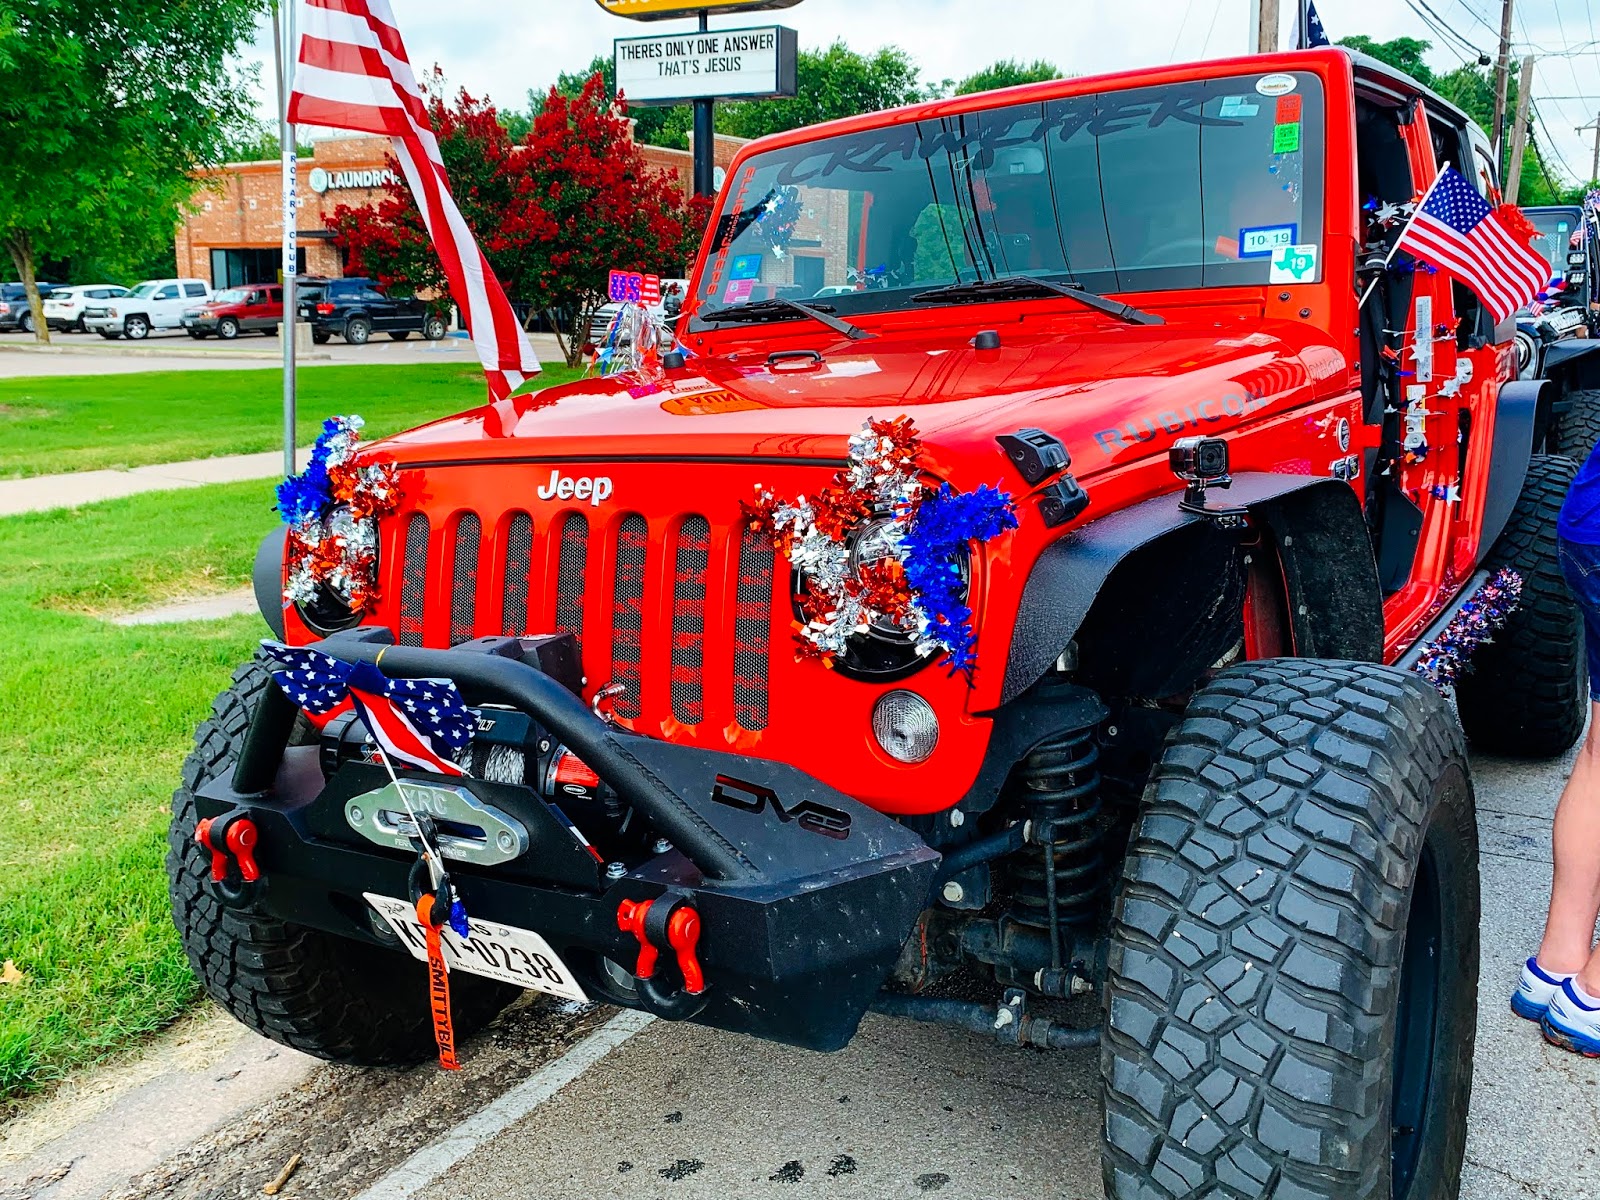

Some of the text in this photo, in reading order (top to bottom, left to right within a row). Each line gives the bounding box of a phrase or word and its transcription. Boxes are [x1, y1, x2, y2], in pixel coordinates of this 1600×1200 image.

[620, 33, 774, 60] THERES ONLY ONE ANSWER
[658, 56, 741, 77] THAT'S JESUS
[288, 154, 297, 273] ROTARY CLUB
[1249, 235, 1266, 246] 10
[1273, 232, 1290, 244] 19
[1289, 256, 1307, 270] 19
[1092, 387, 1267, 455] RUBICON
[537, 469, 613, 507] Jeep
[403, 788, 449, 816] XRC
[430, 955, 455, 1067] SMITTYBILT
